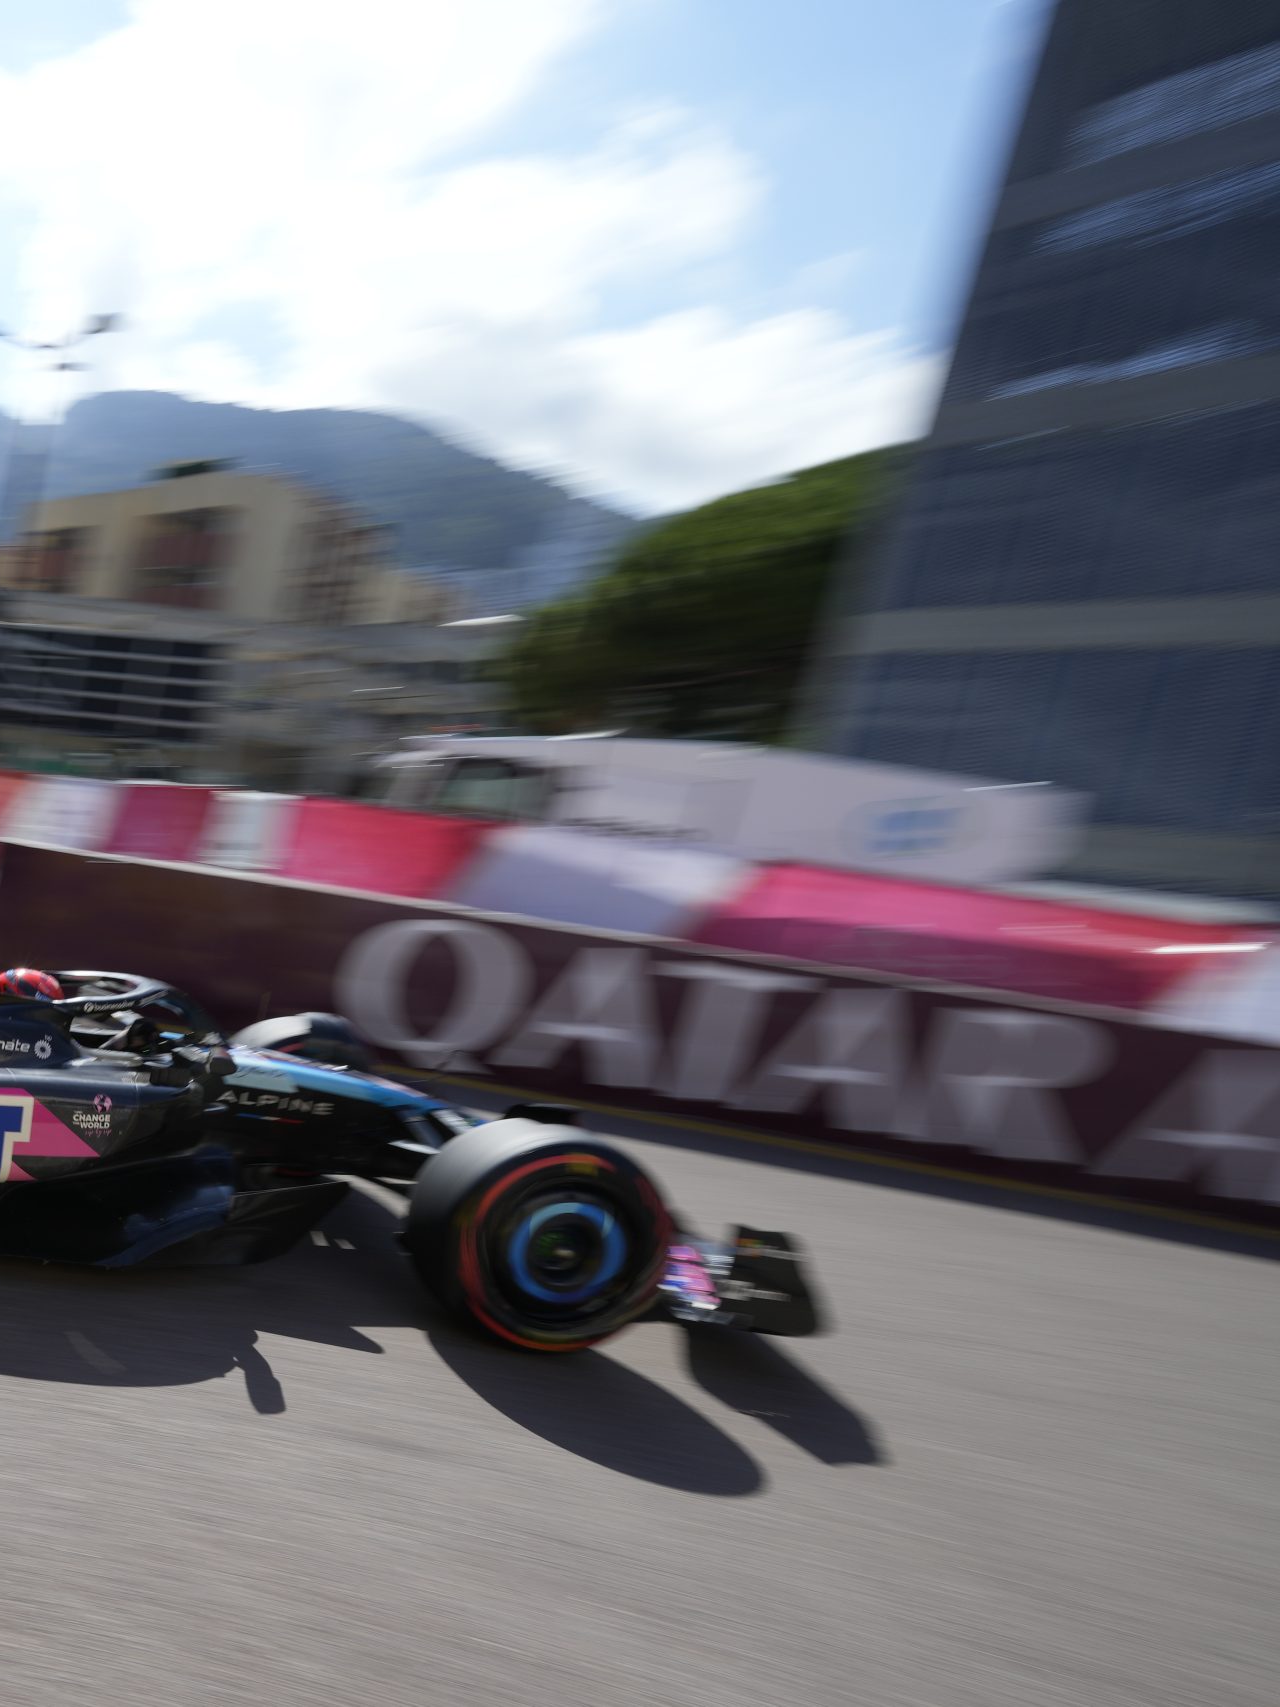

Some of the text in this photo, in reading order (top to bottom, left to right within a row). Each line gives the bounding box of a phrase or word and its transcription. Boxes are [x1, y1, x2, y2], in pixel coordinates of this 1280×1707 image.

[333, 918, 1108, 1166] QATAR
[215, 1089, 336, 1116] ALPINE
[72, 1113, 111, 1122] CHANGE
[80, 1121, 110, 1129] WORLD
